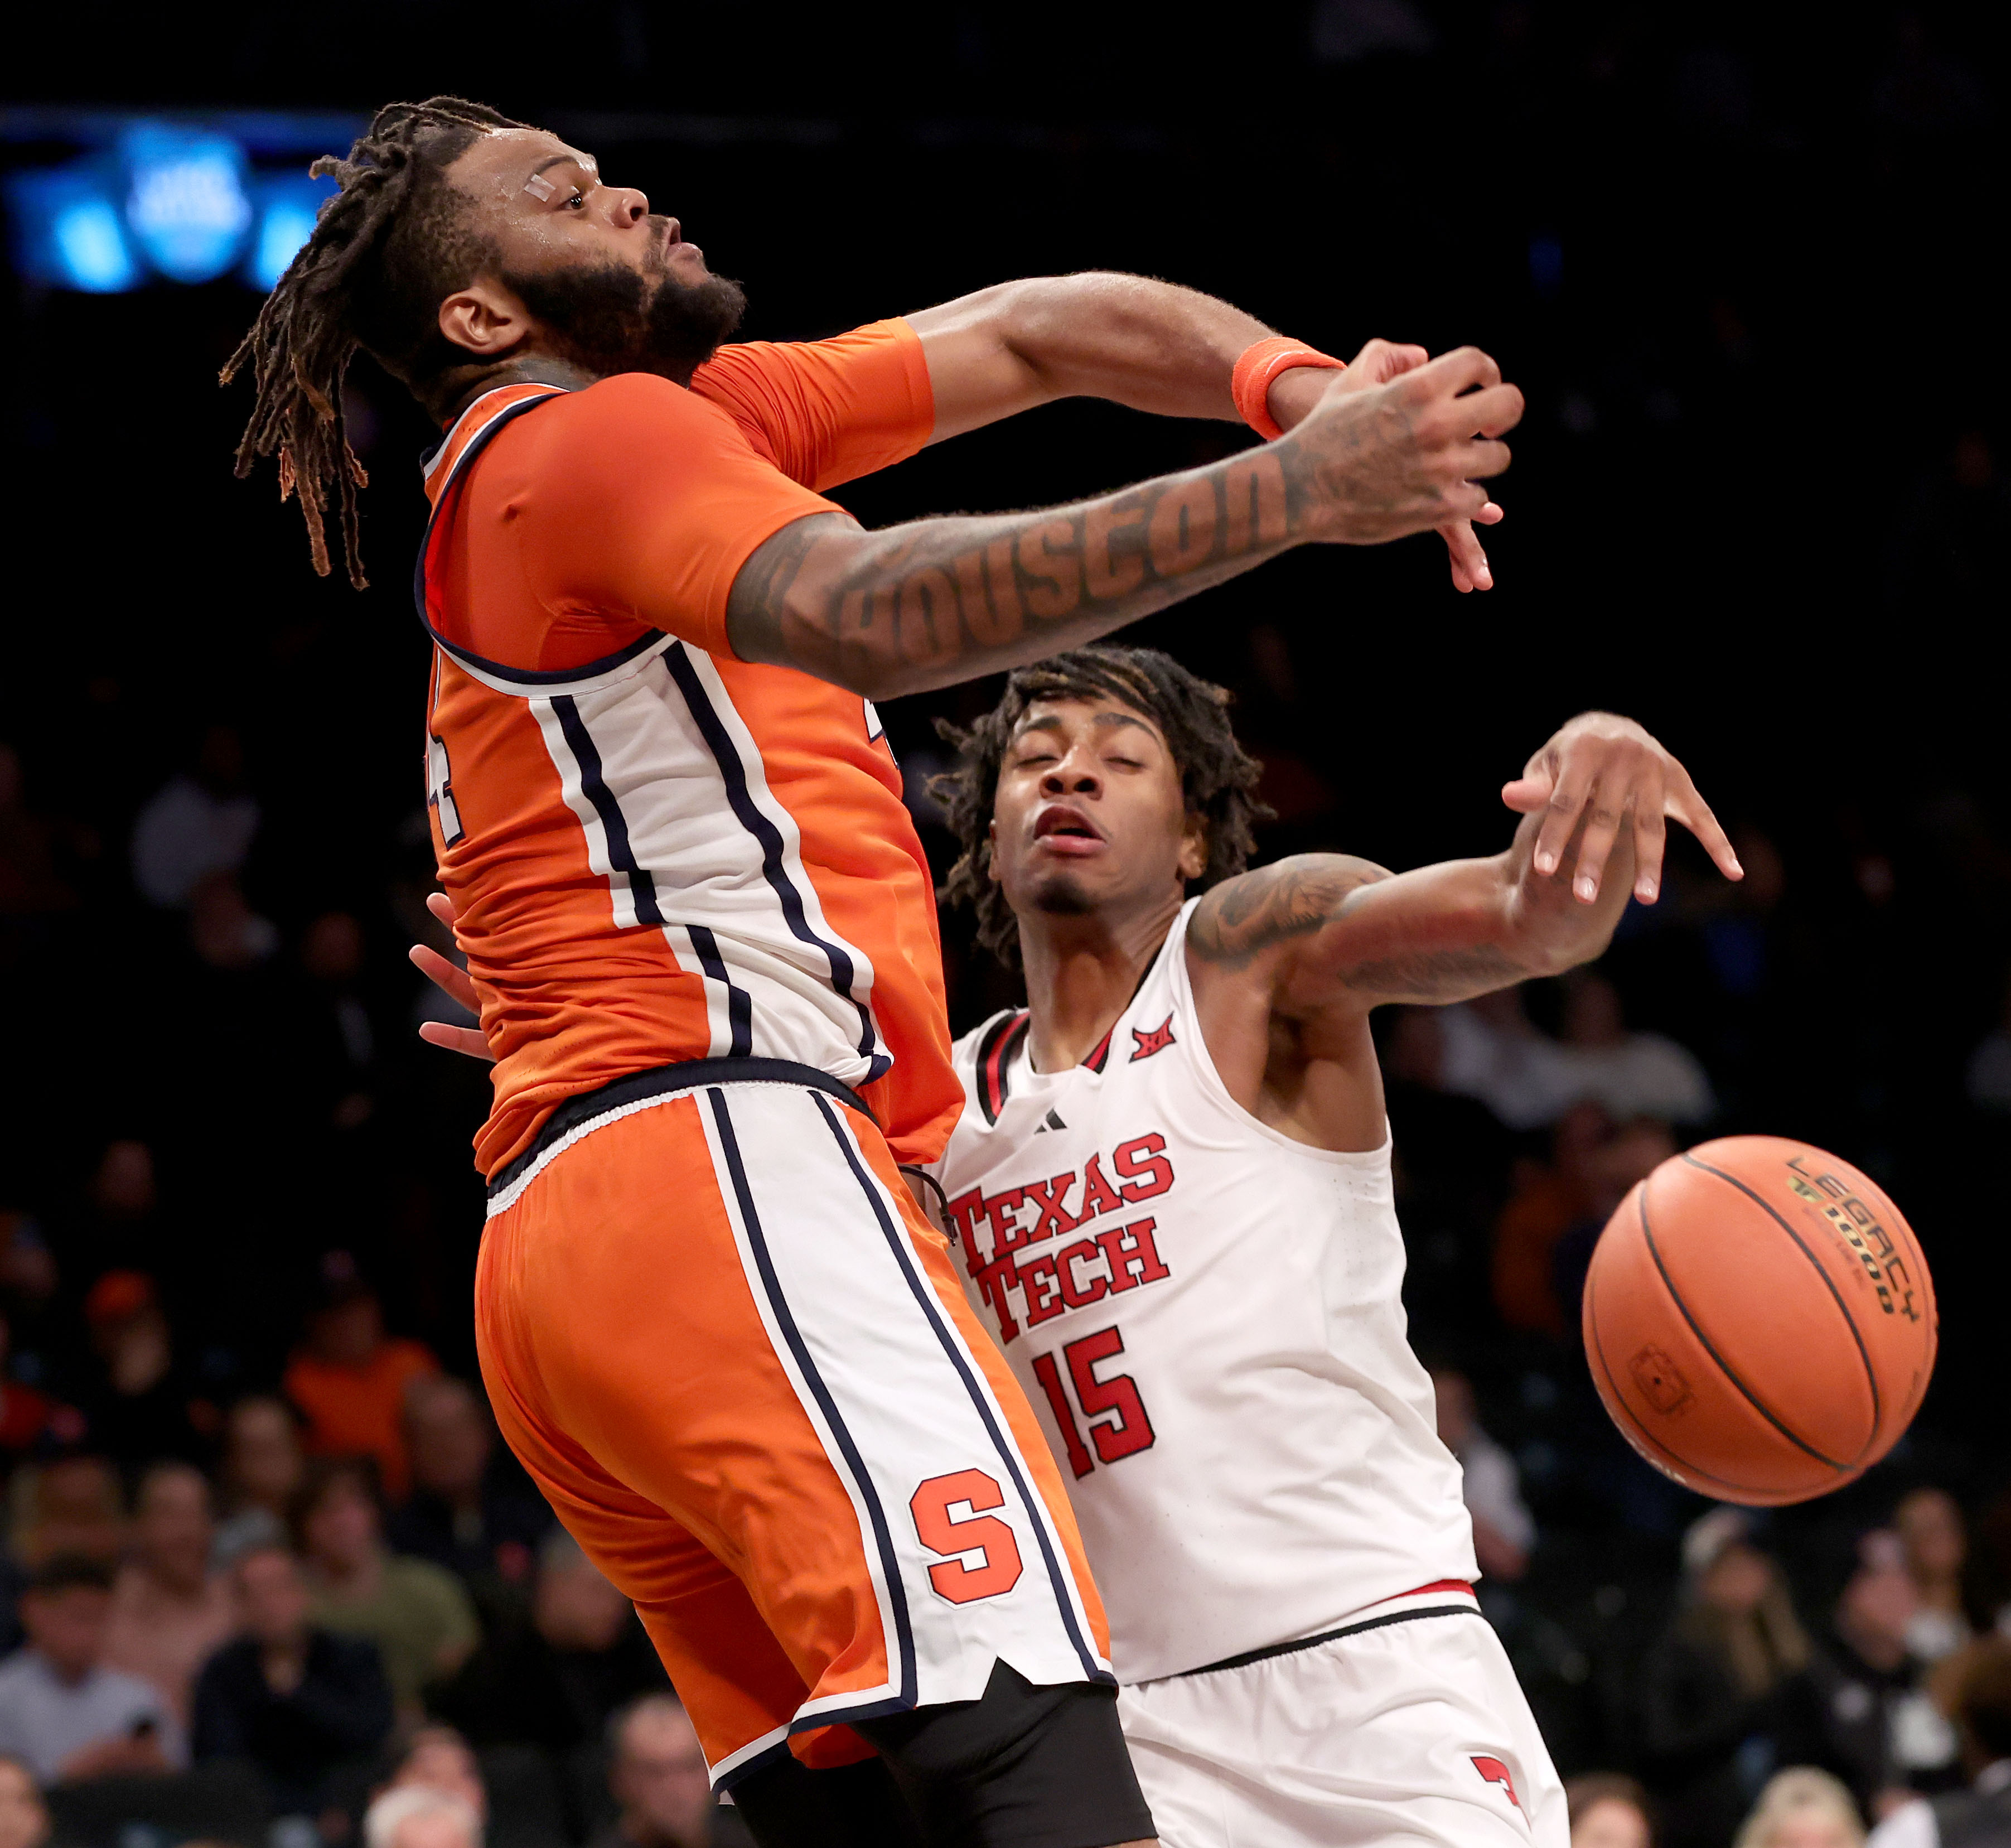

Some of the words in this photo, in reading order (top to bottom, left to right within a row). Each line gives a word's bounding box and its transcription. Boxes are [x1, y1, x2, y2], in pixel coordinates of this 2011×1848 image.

[948, 1132, 1174, 1278] TEXAS
[1786, 1155, 1920, 1323] LEGACY
[975, 1217, 1171, 1344] TECH
[1032, 1325, 1156, 1480] 15
[909, 1467, 1024, 1605] S
